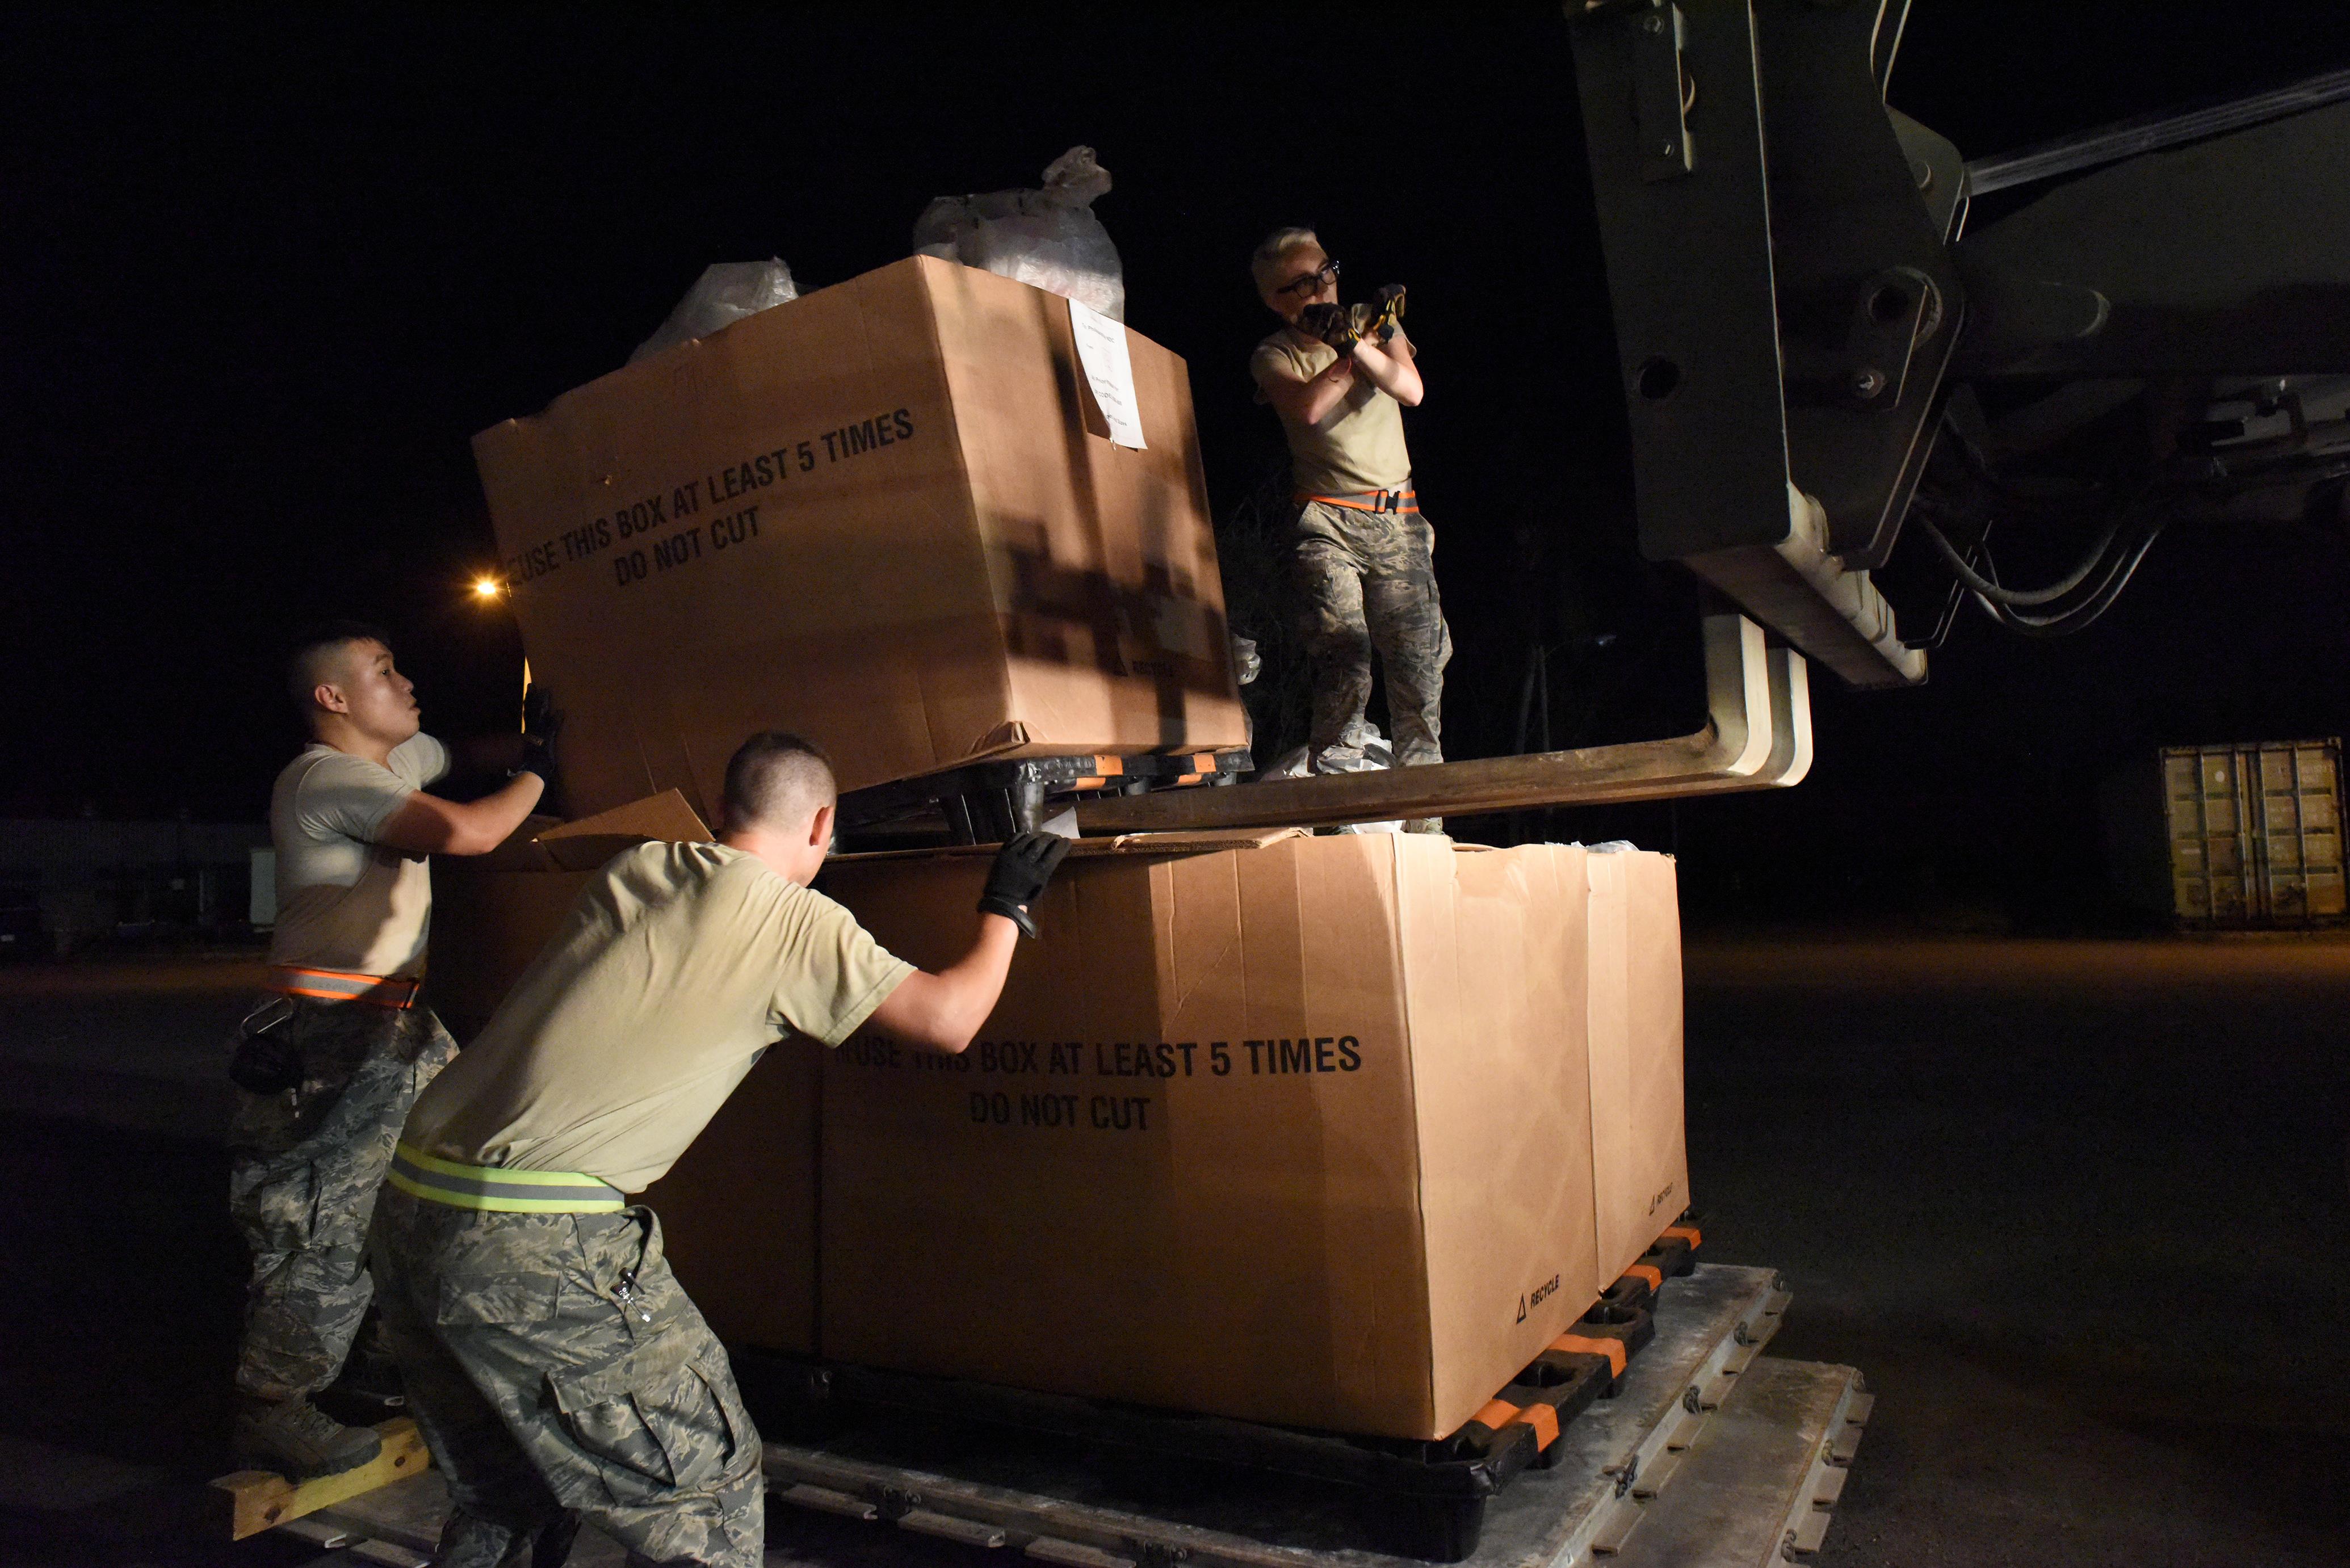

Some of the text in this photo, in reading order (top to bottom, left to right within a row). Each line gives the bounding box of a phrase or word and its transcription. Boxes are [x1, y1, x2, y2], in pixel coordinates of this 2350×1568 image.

[560, 518, 611, 562] THIS
[616, 495, 666, 539] BOX
[672, 481, 700, 518] AT
[708, 448, 790, 505] LEAST
[795, 441, 816, 472] 5
[821, 408, 914, 463] TIMES
[614, 506, 760, 586] DO NOT CUT
[980, 1040, 1039, 1074] BOX
[1048, 1041, 1083, 1075] AT
[1096, 1041, 1197, 1078] LEAST
[1210, 1041, 1232, 1077] 5
[1243, 1035, 1362, 1075] TIMES
[970, 1091, 1151, 1130] DO NOT CUT
[1530, 1273, 1559, 1309] RECYCLE
